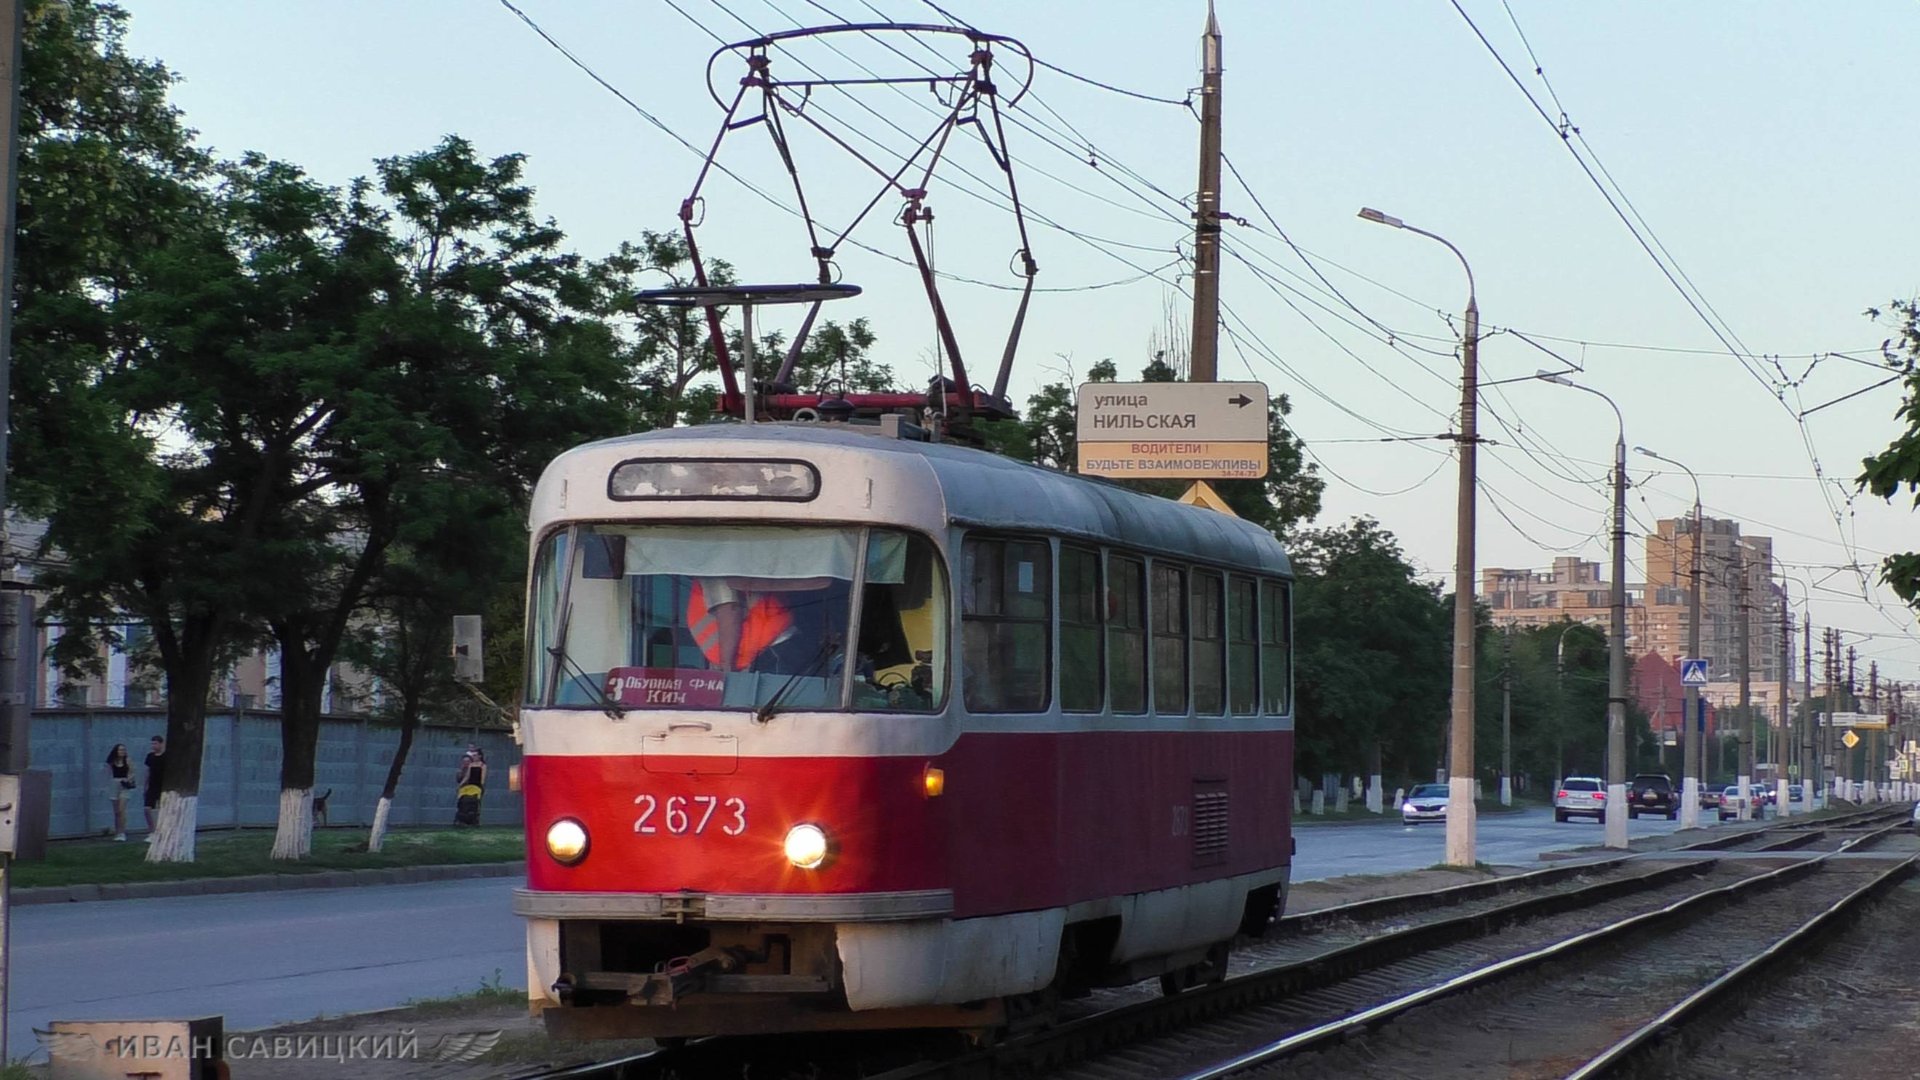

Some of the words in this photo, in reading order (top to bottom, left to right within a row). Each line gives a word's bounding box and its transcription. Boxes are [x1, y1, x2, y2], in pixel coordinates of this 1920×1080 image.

[1094, 395, 1148, 409] улица
[1093, 414, 1196, 429] НИЛЬСКАЯ
[1131, 443, 1201, 454] ВОДИТЕЛИ
[1086, 459, 1134, 470] БУДЬТЕ
[1139, 459, 1261, 470] ВЗАИМОВЕЖЛИВЫ
[606, 676, 624, 702] 3
[625, 675, 683, 691] ОБУВНАЯ
[633, 794, 746, 836] 2673
